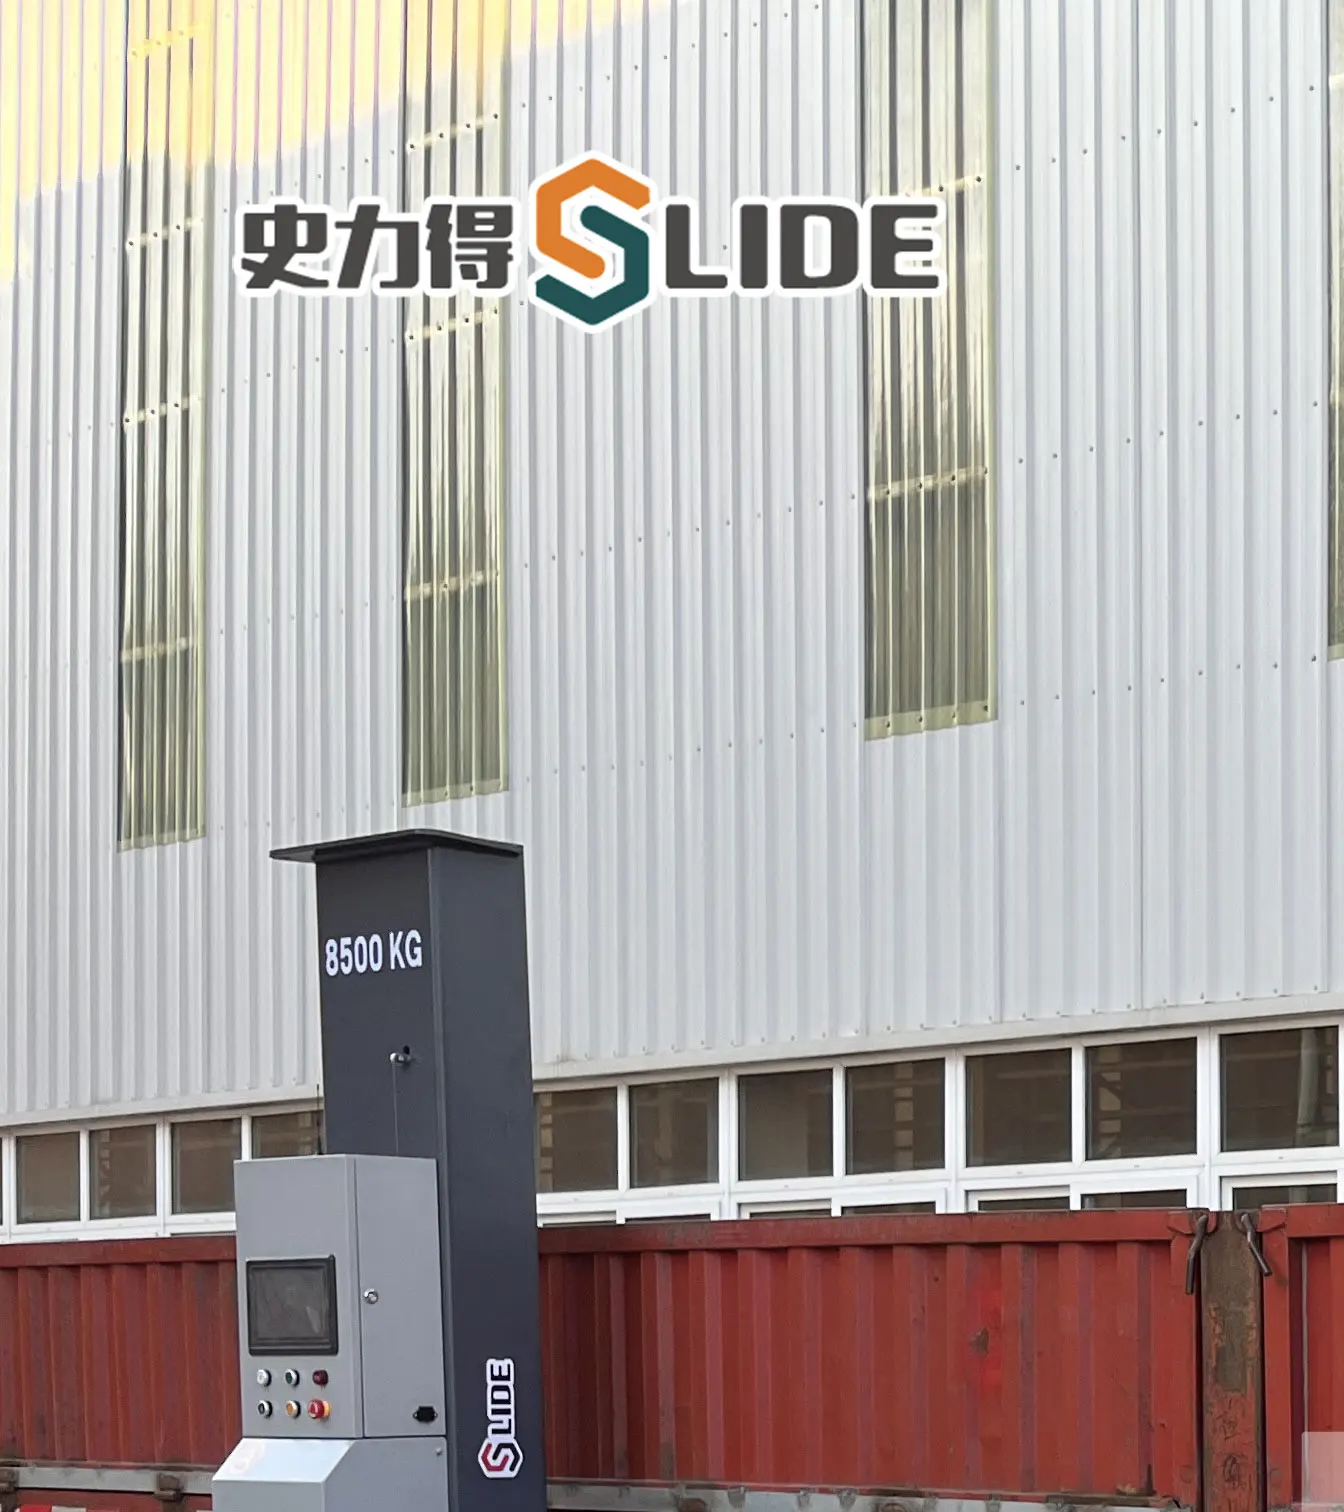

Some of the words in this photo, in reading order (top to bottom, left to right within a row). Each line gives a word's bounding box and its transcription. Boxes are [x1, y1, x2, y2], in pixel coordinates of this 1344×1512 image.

[325, 934, 383, 976] 8500
[389, 929, 422, 970] KG
[480, 1361, 521, 1473] SLIDE
